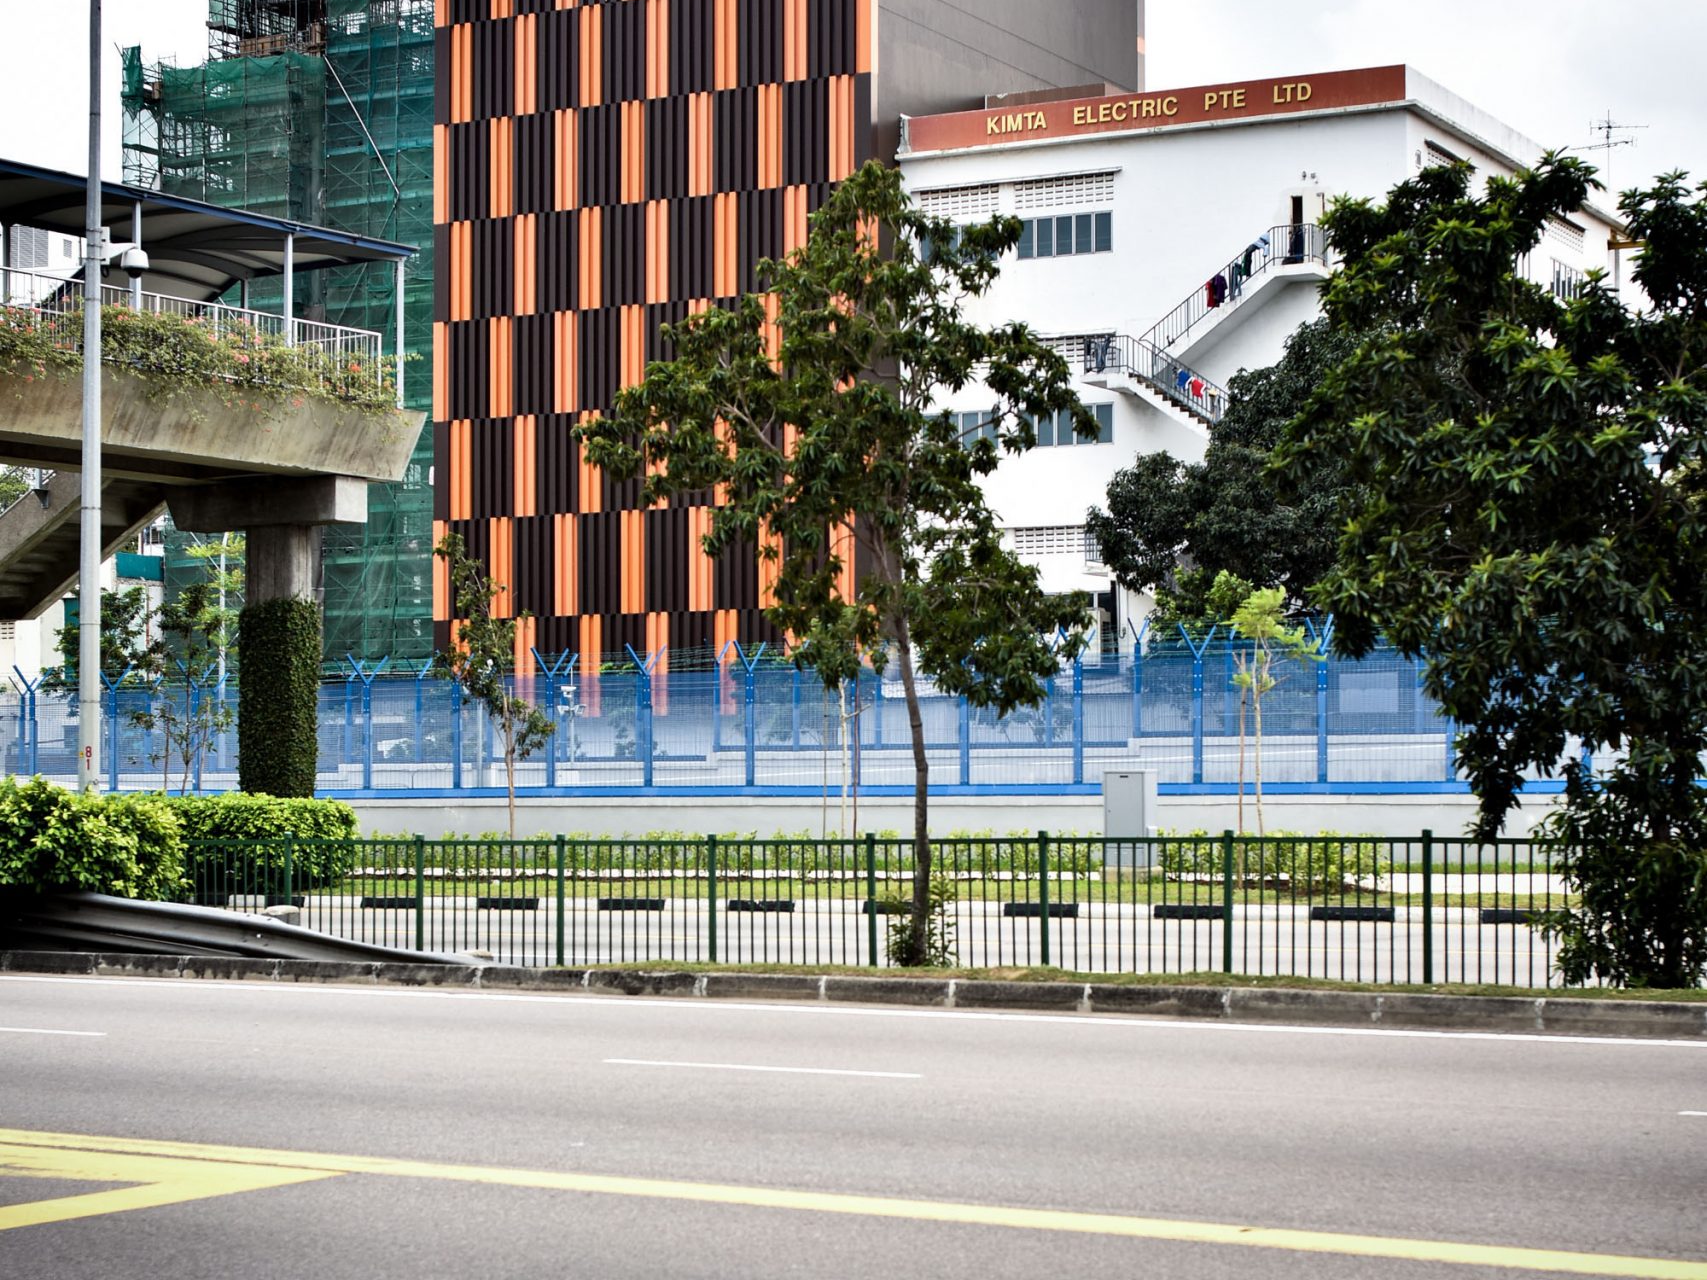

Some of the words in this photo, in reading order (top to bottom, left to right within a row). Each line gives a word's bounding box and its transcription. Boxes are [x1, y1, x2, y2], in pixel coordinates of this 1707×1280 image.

[985, 110, 1047, 135] KIMTA
[1073, 96, 1178, 125] ELECTRIC
[1204, 89, 1246, 111] PTE
[1273, 83, 1312, 104] LTD
